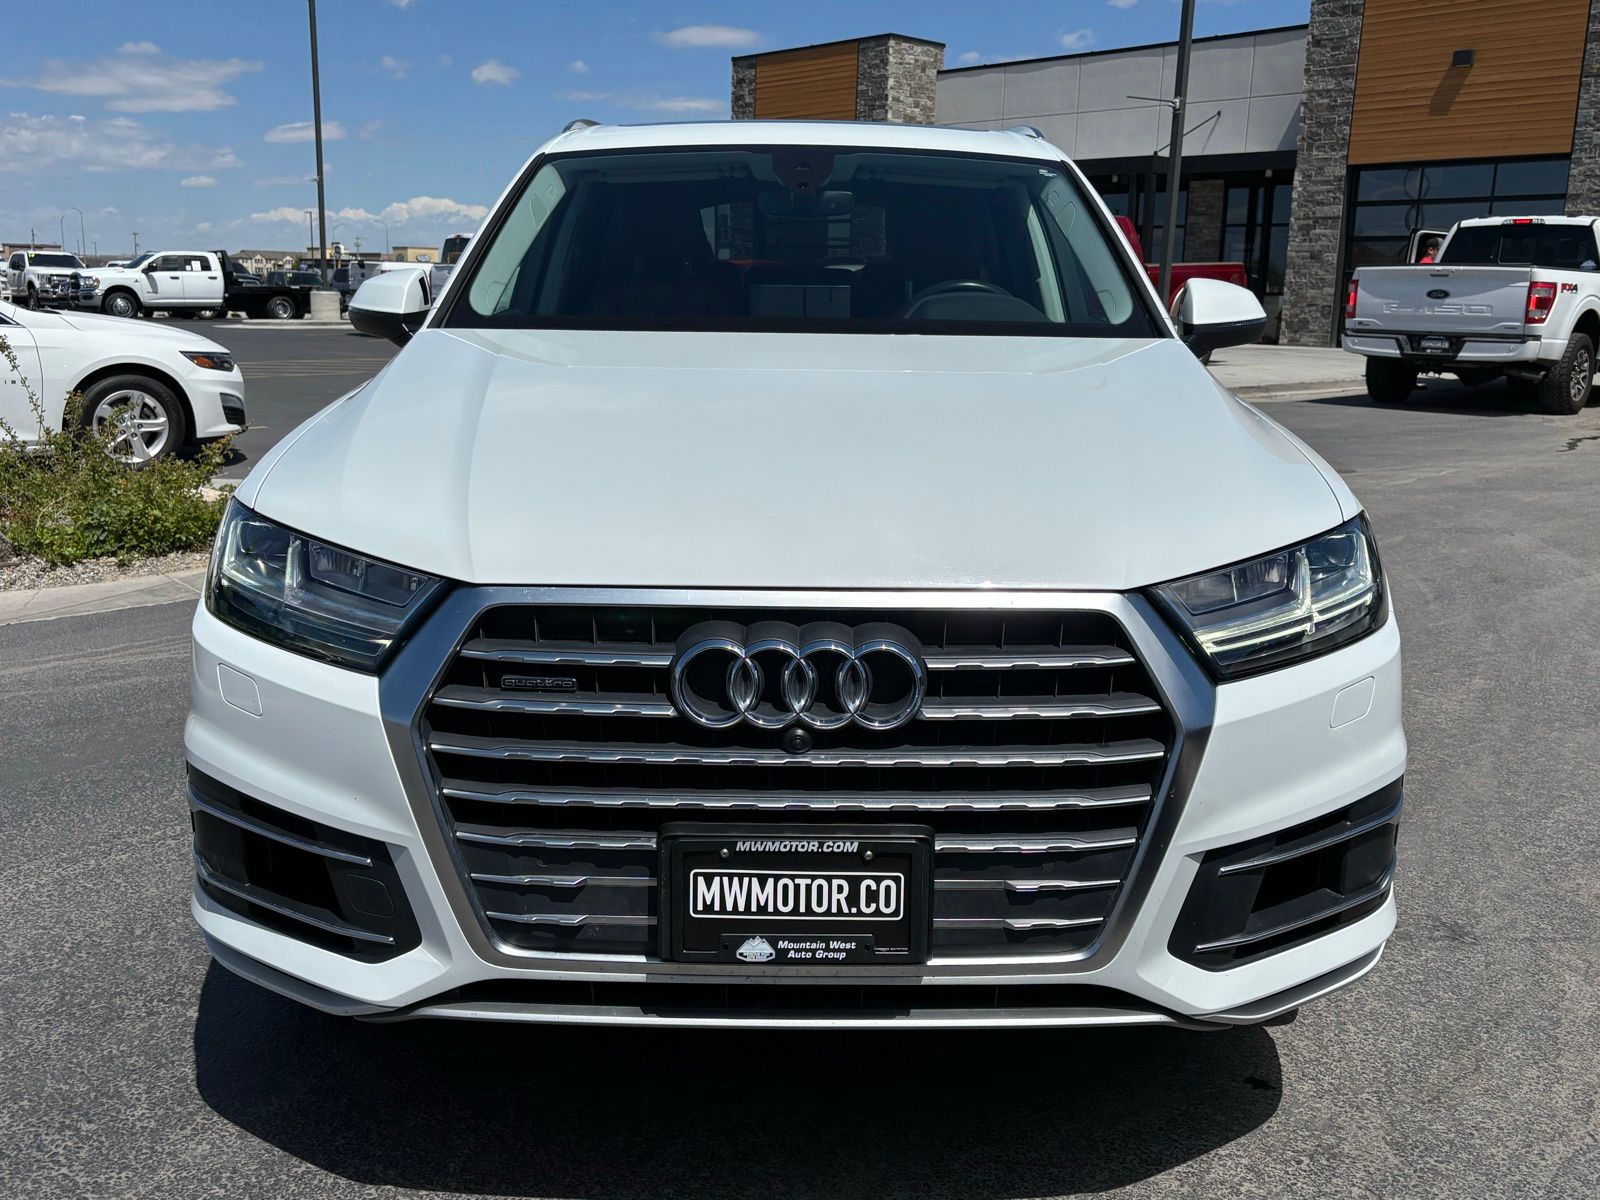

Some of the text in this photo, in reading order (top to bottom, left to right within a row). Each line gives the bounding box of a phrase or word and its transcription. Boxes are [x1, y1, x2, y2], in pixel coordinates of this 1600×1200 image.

[1560, 283, 1578, 294] FX4
[504, 678, 572, 688] quattro
[735, 841, 859, 853] MWMOTOR.COM
[696, 875, 897, 914] MWMOTOR.CO
[777, 940, 857, 949] Mountain West
[787, 950, 847, 960] Auto Group
